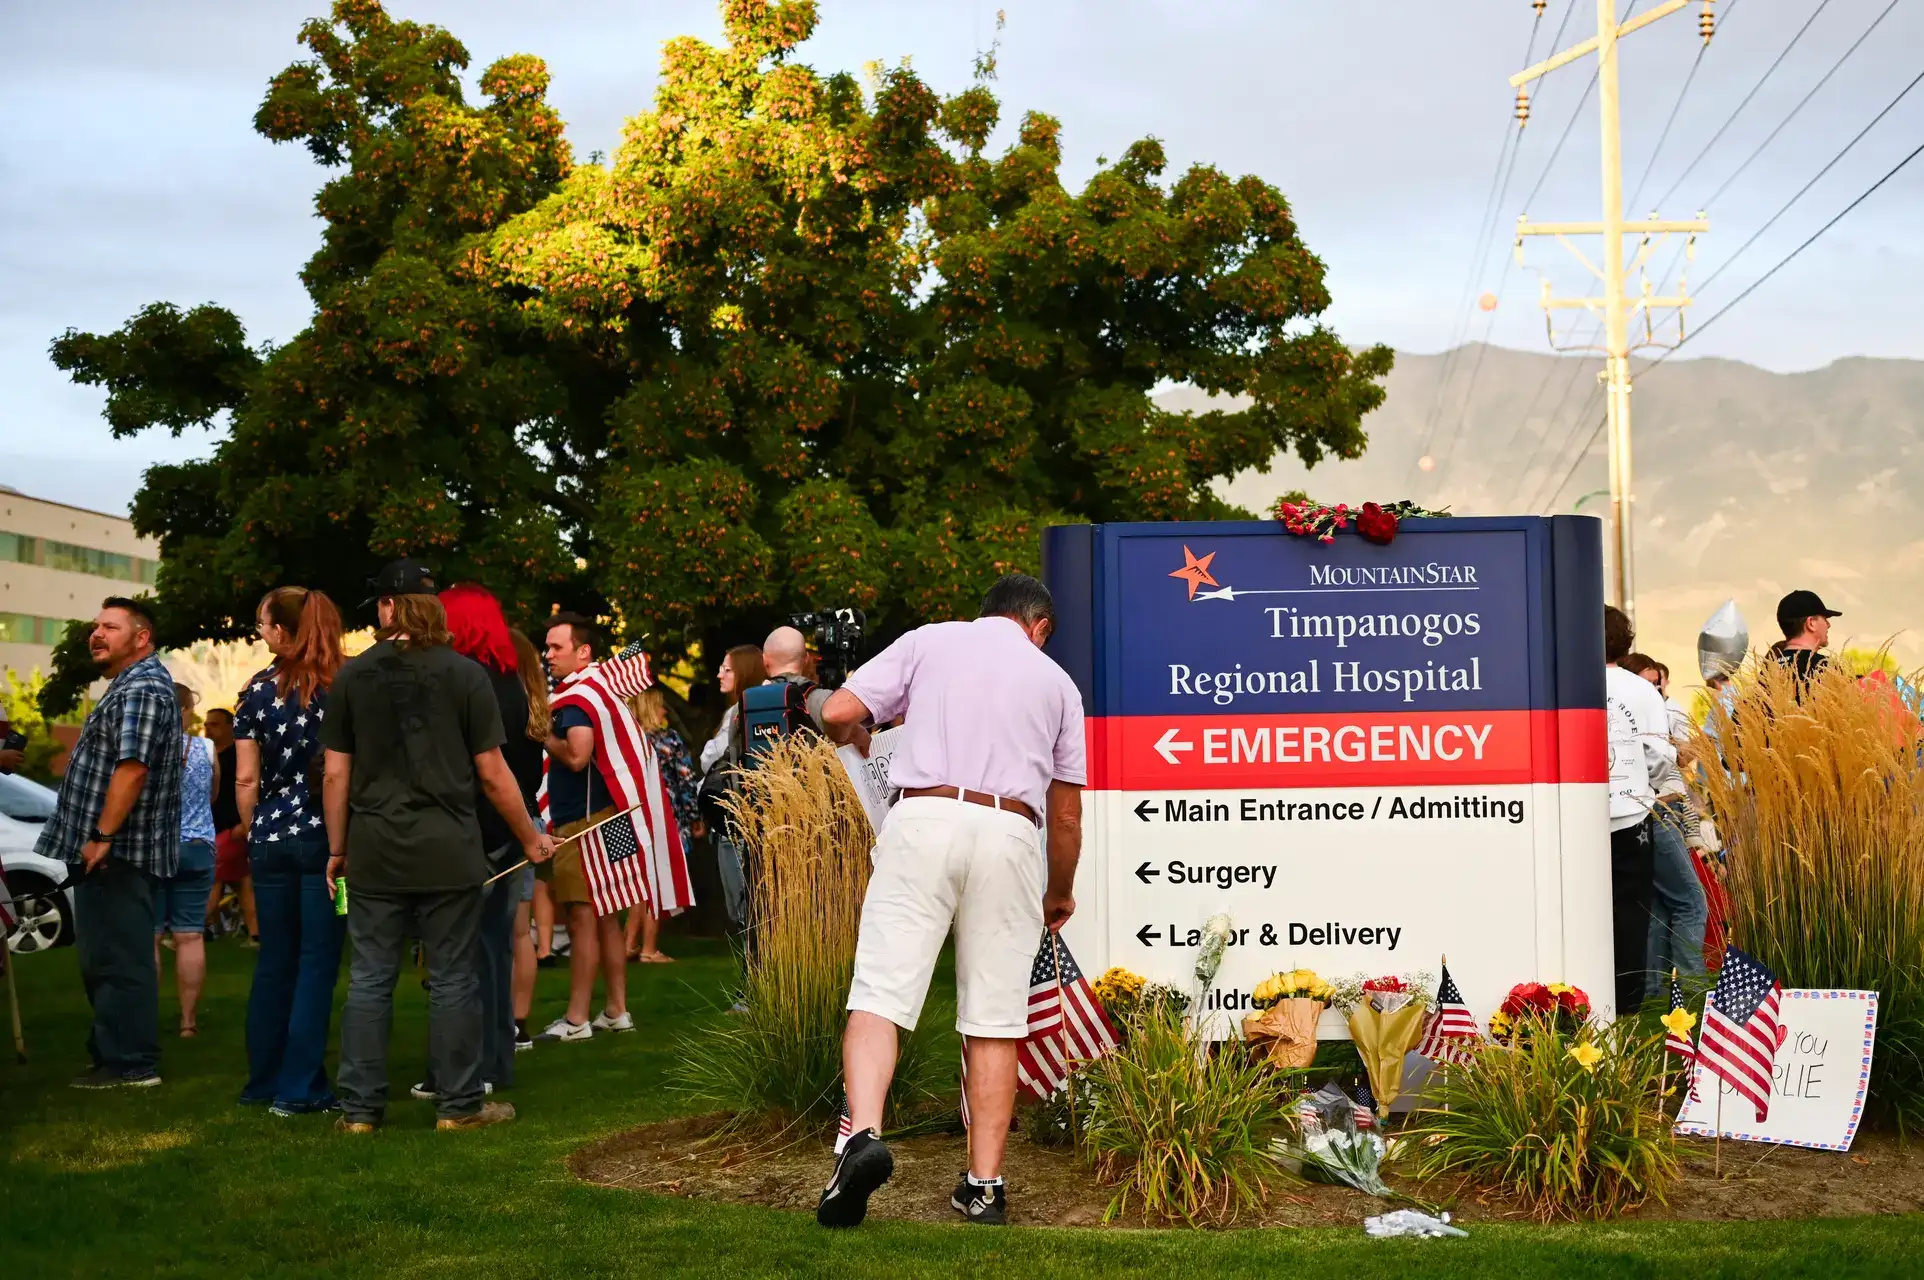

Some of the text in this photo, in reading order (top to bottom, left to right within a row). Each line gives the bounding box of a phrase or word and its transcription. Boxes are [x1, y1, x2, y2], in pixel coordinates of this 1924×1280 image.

[1264, 607, 1481, 648] Timpanogos
[1168, 656, 1483, 706] Regional Hospital
[1203, 724, 1493, 764] EMERGENCY
[1165, 795, 1525, 824] Main Entrance / Admitting
[1167, 860, 1278, 890] Surgery
[1169, 922, 1402, 951] Laor & Delivery
[1794, 1030, 1829, 1059] YOU
